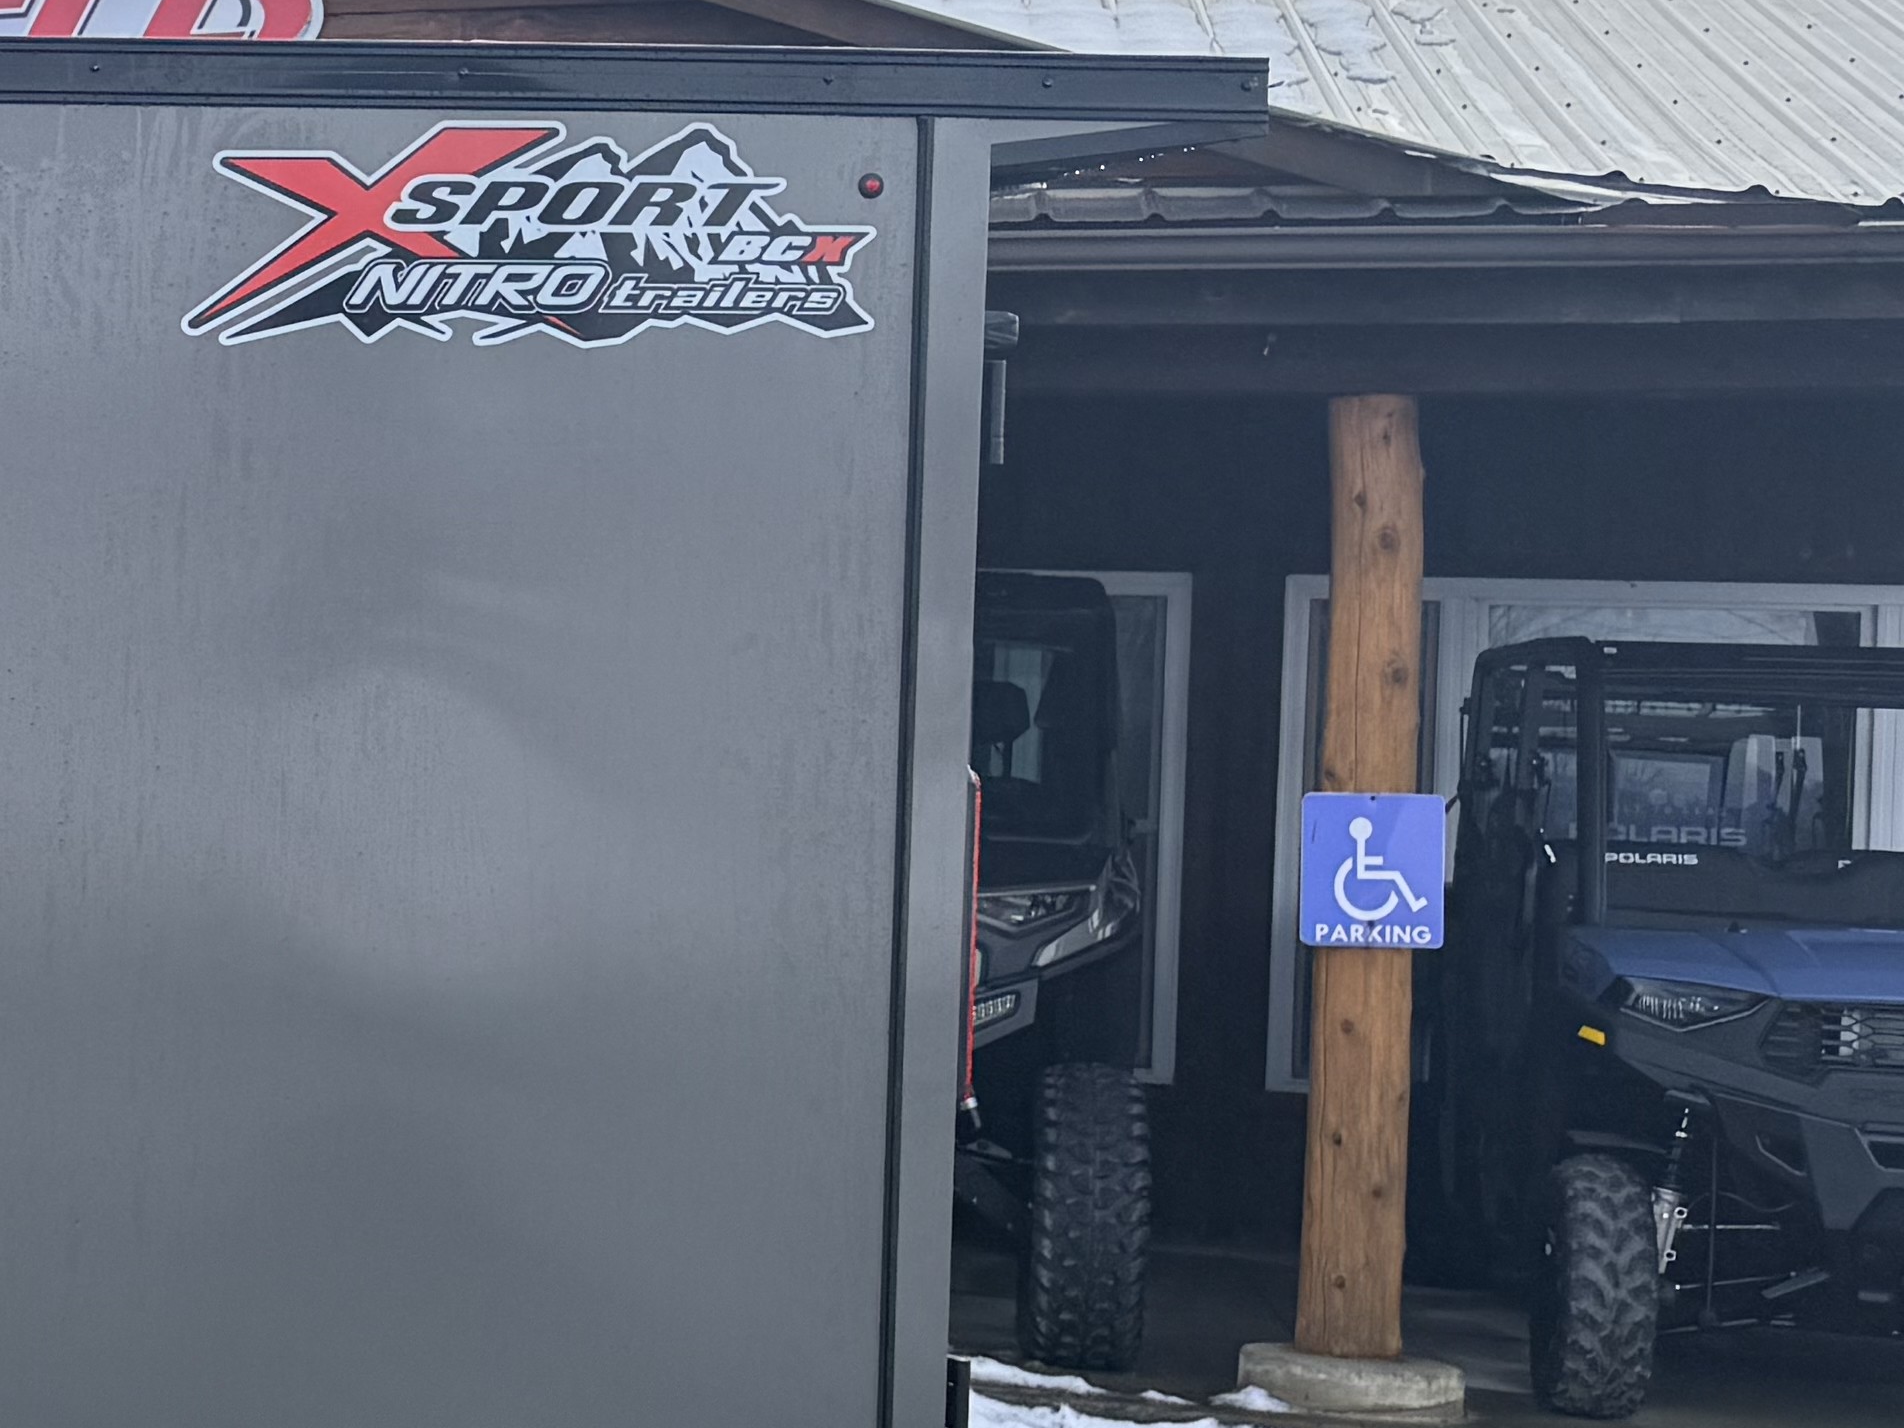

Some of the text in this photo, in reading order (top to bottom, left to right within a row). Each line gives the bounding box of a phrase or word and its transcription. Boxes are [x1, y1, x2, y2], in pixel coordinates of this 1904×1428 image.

[352, 262, 840, 312] NITRO trailers
[1603, 851, 1699, 866] POLARIS
[1314, 923, 1432, 945] PARKING
